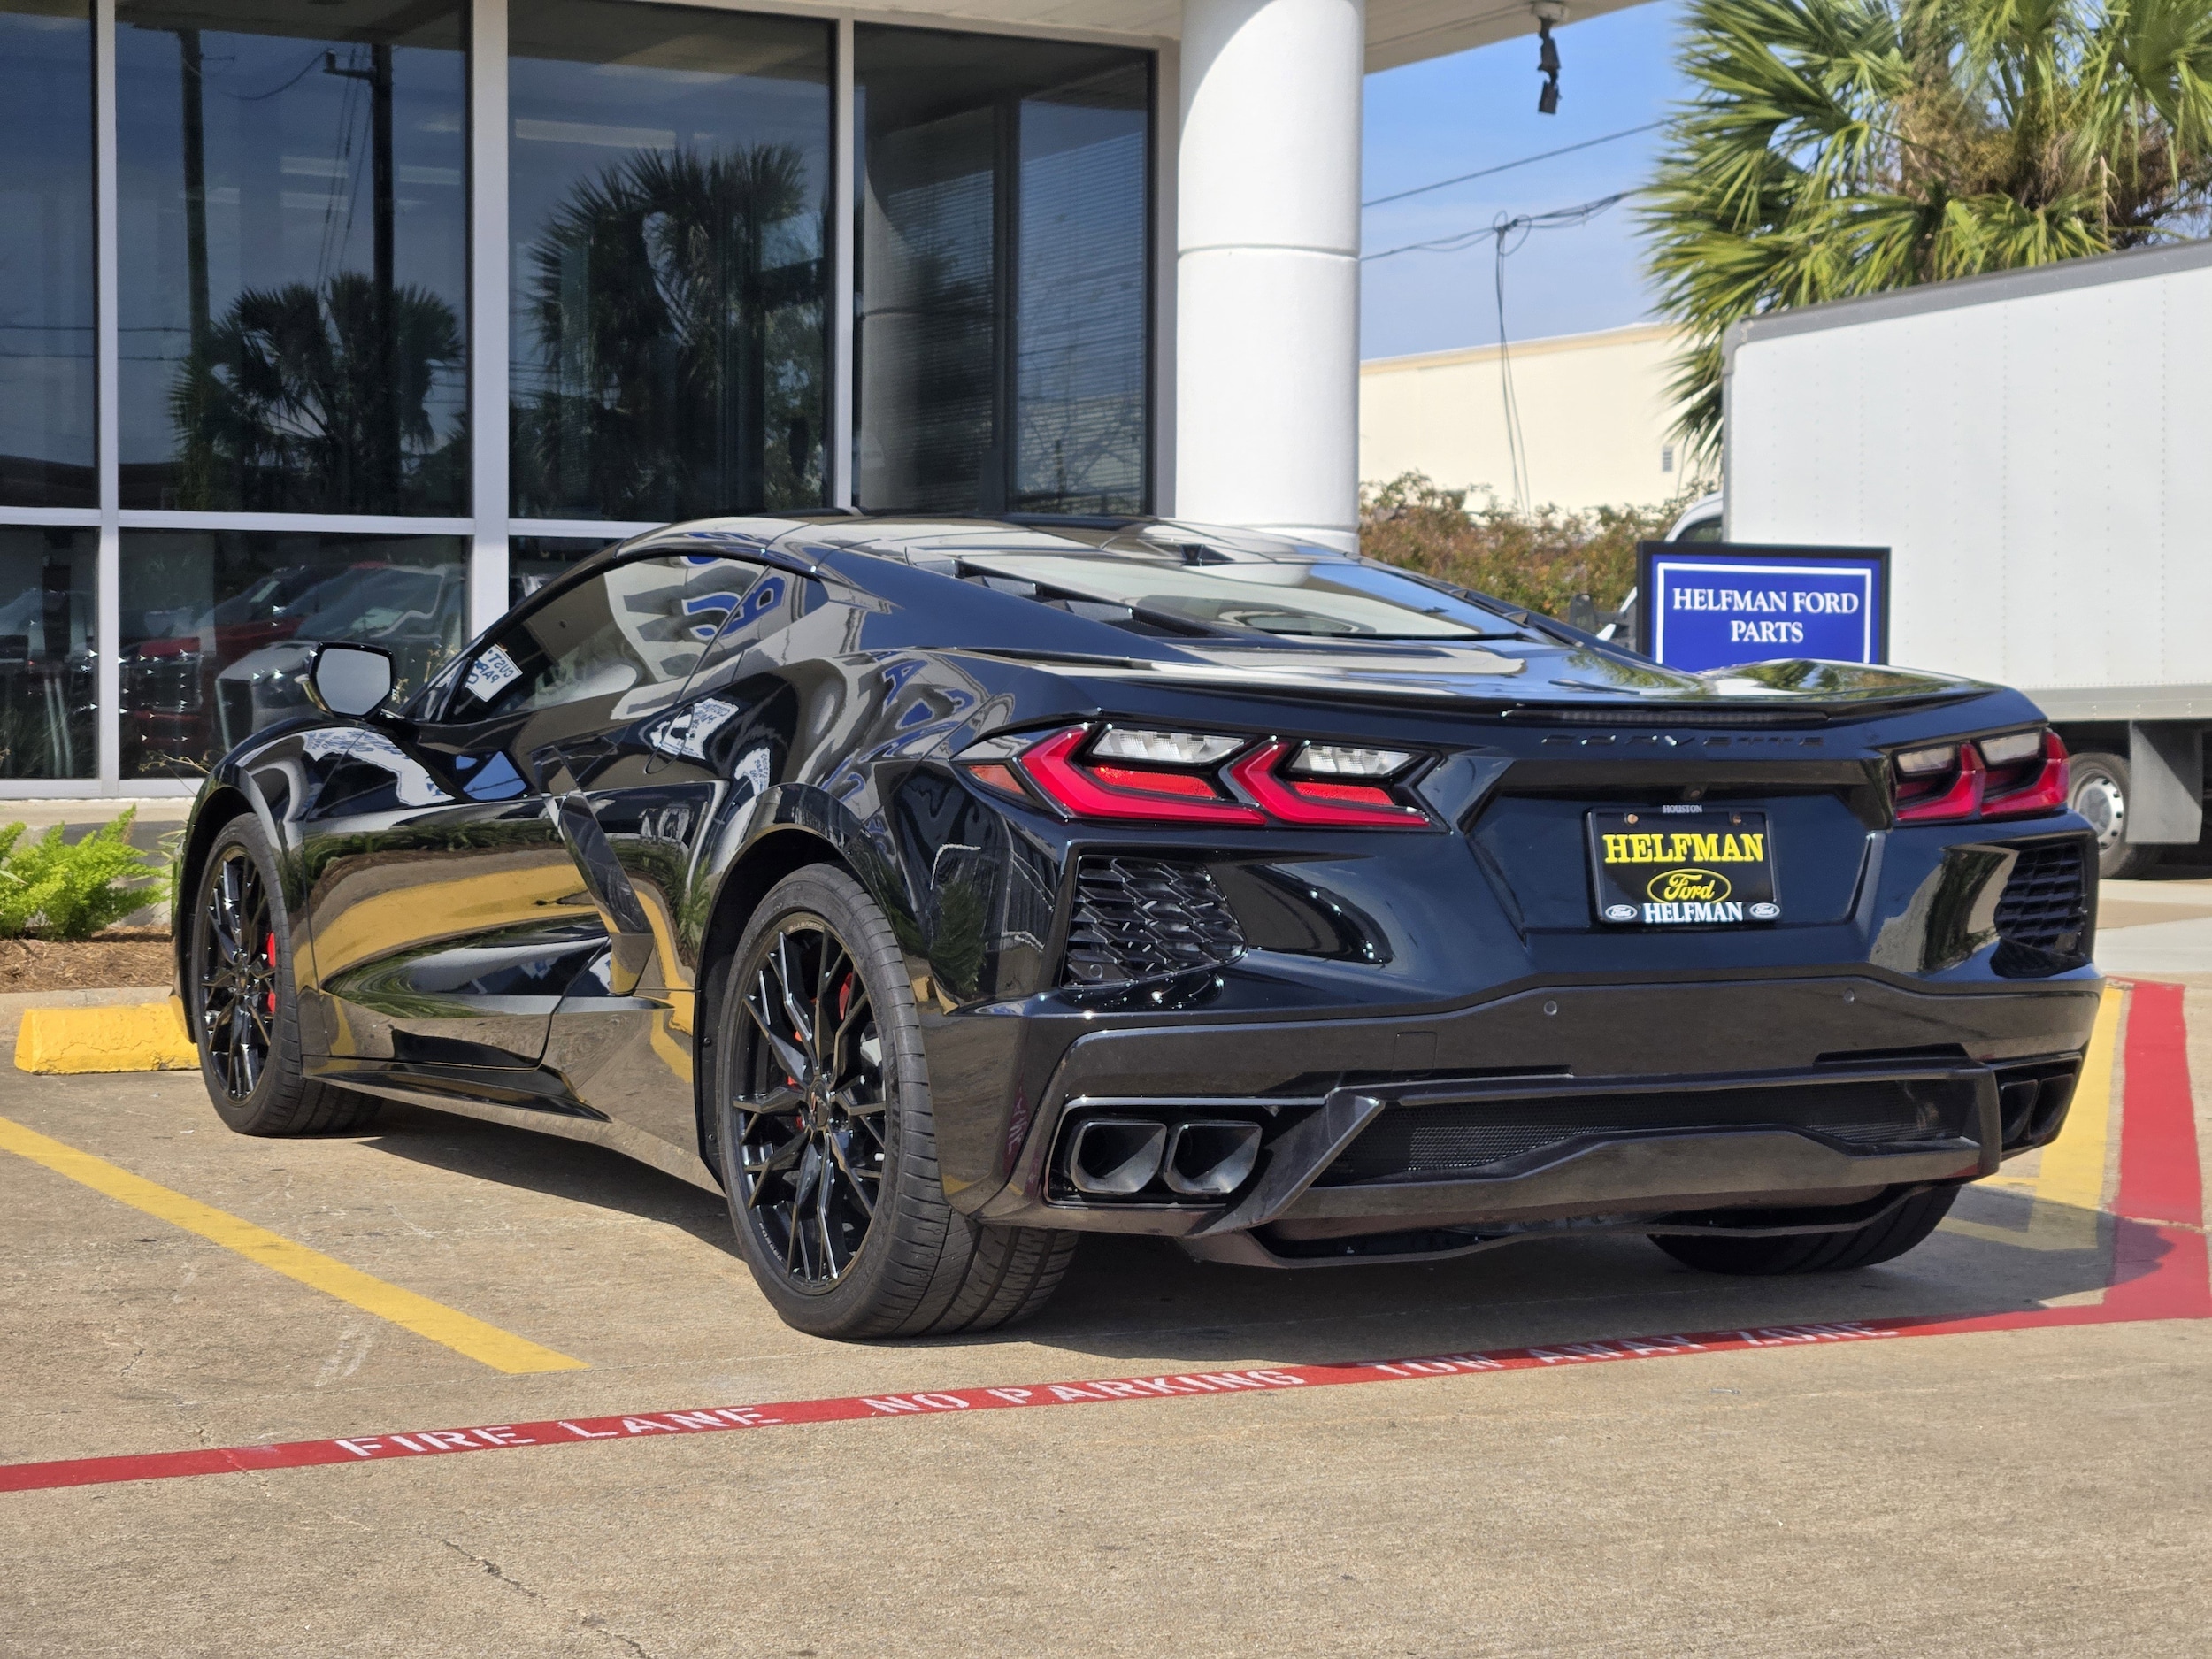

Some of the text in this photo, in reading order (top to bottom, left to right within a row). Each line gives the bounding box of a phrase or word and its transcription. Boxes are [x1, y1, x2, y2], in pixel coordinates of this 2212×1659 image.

[1673, 588, 1859, 614] HELFMAN FORD
[1731, 620, 1804, 643] PARTS
[1663, 804, 1702, 814] HOUSTON
[1602, 833, 1763, 863] HELFMAN
[1663, 872, 1716, 900] Ford
[1643, 902, 1743, 923] HELFMAN
[334, 1322, 1900, 1456] FIRE LANE NO PARKING TOW AWAY ZONE
